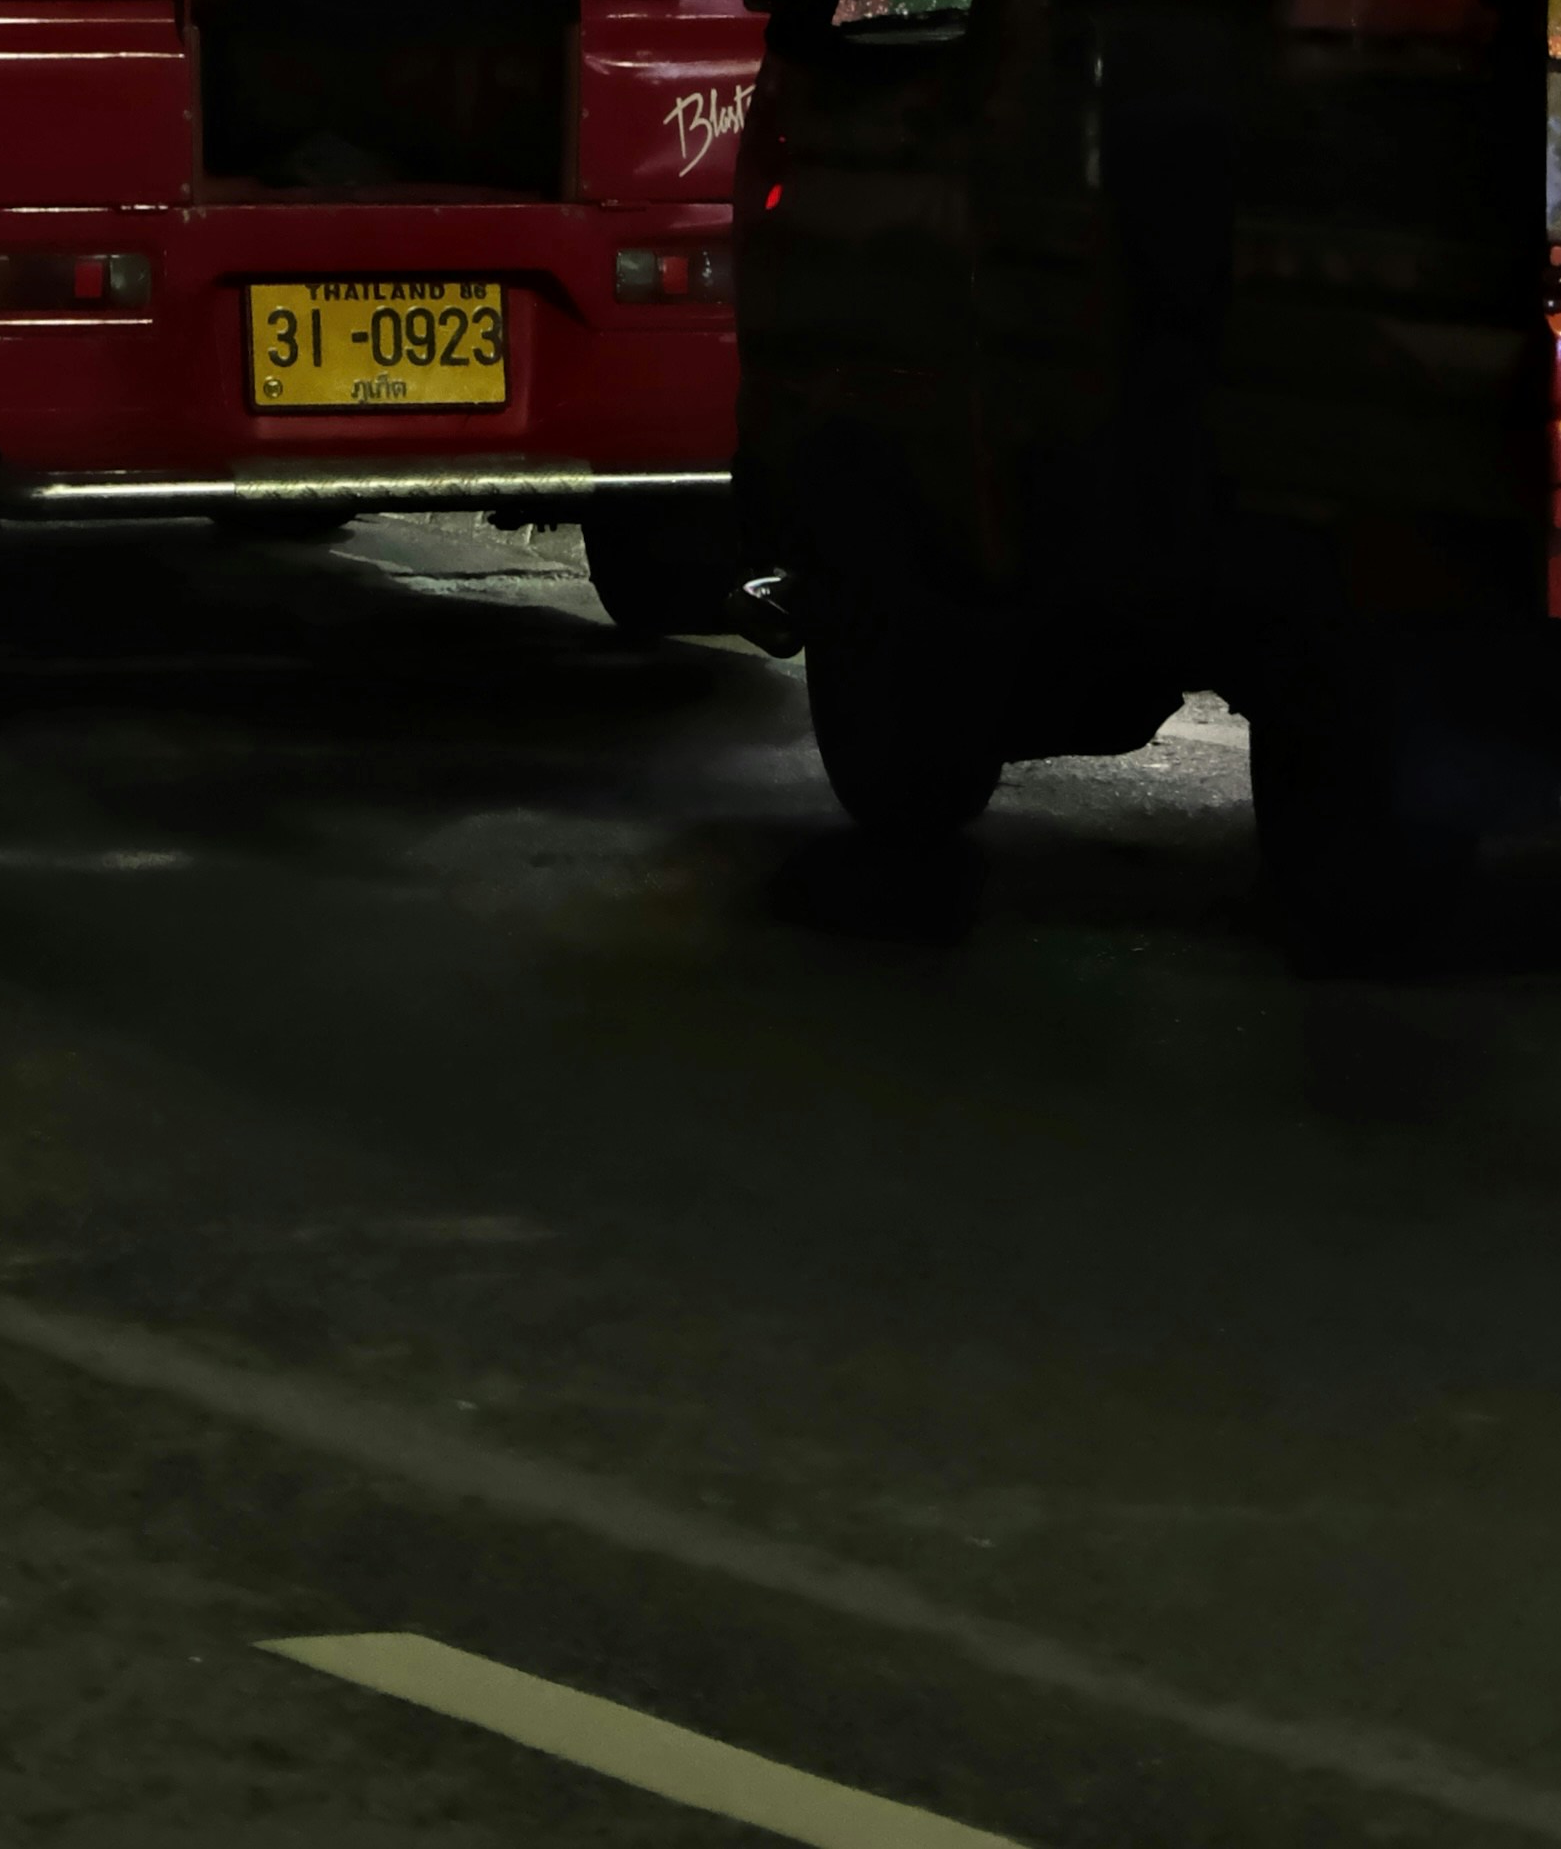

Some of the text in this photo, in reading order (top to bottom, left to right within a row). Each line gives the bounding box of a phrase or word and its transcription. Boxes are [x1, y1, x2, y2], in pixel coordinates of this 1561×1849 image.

[662, 84, 756, 178] Blast
[305, 284, 445, 301] THAILAND
[351, 372, 407, 403] ภูเก็ต
